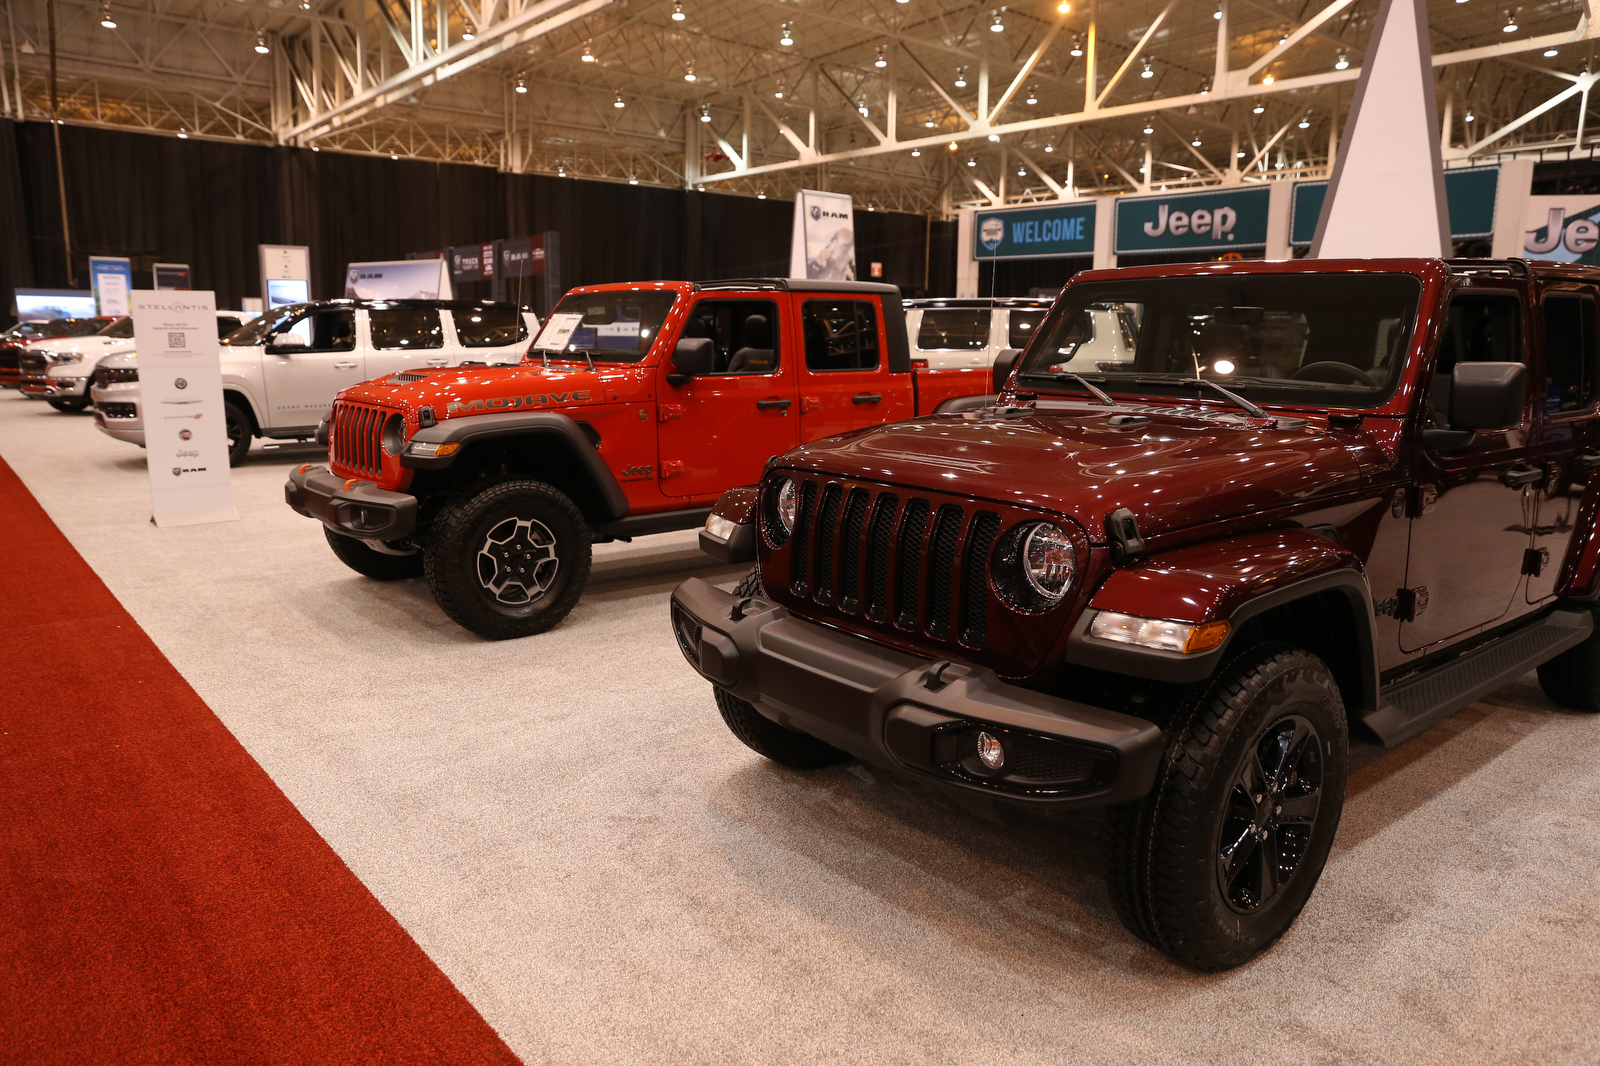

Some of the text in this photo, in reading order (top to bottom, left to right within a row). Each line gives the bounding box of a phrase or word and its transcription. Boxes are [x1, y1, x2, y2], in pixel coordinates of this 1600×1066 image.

[822, 211, 849, 219] RAM
[1143, 204, 1237, 240] Jeep
[1012, 217, 1085, 243] WELCOME
[446, 390, 592, 413] MOJAVE
[622, 463, 653, 477] Jeep
